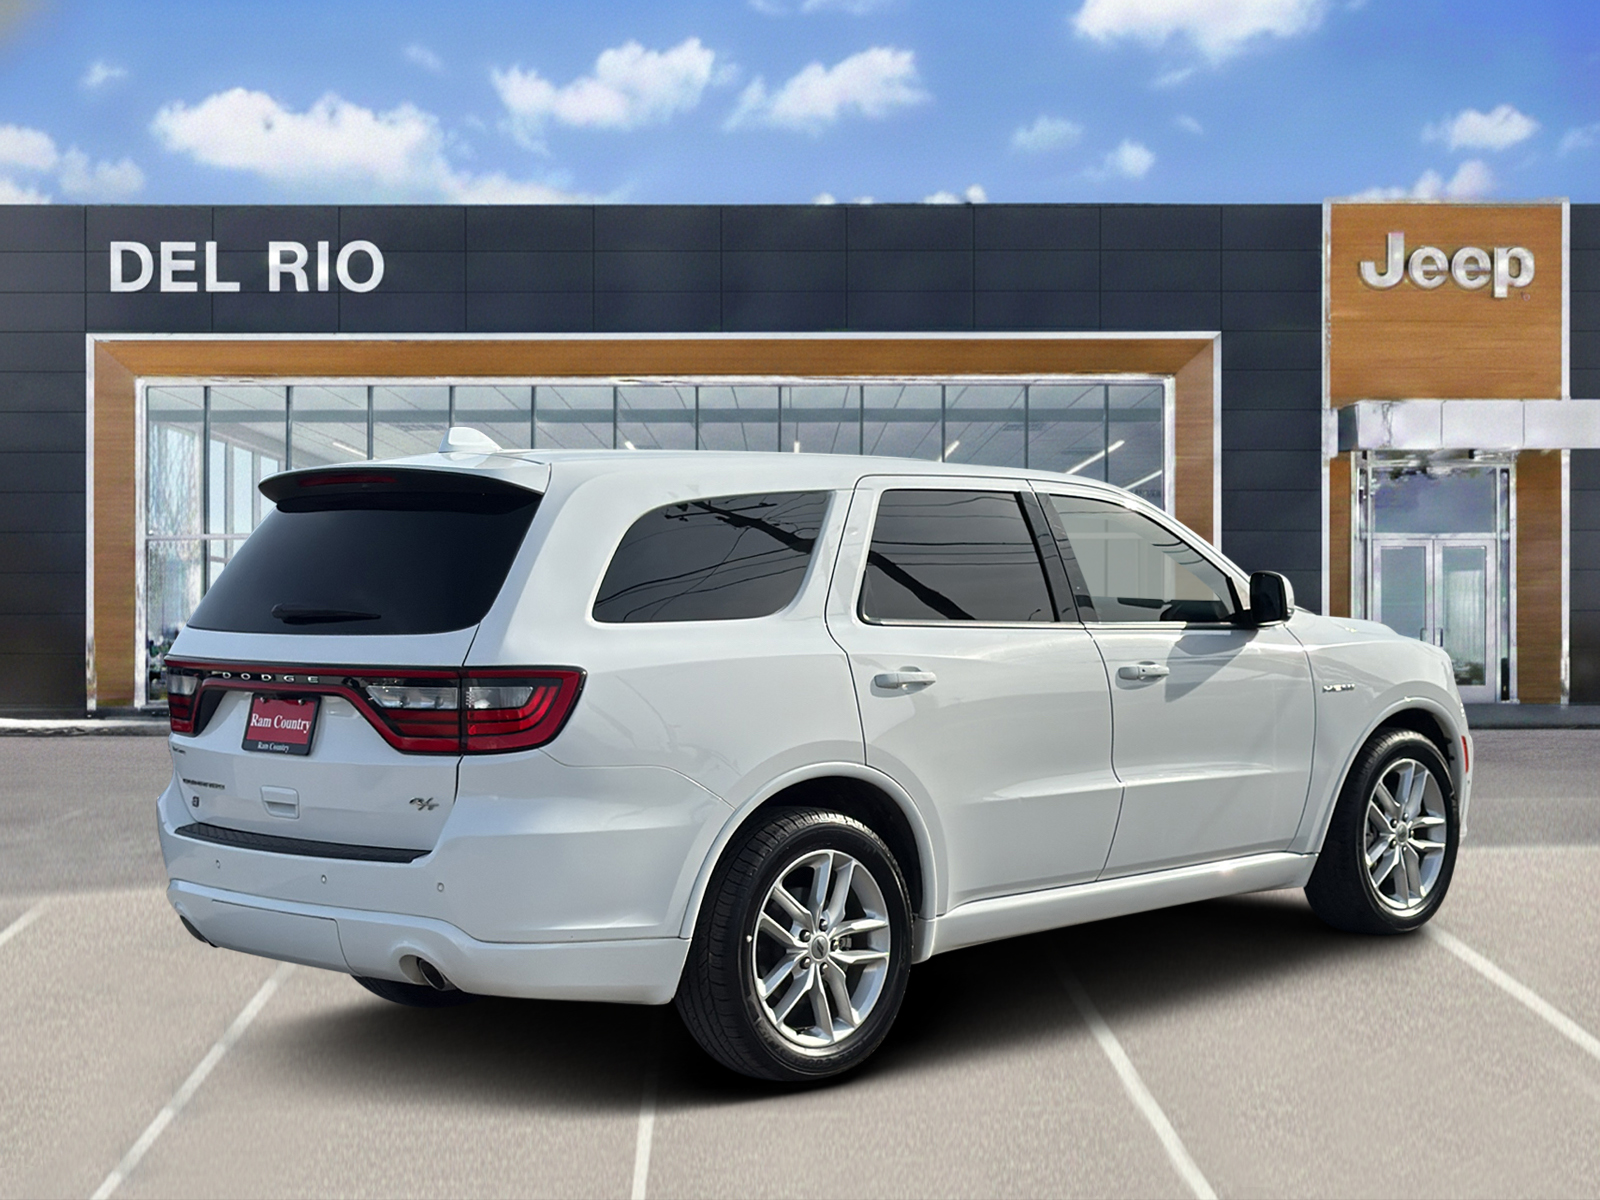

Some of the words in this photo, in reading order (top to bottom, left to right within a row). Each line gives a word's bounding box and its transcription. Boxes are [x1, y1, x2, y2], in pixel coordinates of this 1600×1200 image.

[110, 241, 241, 293] DEL
[268, 240, 385, 293] RIO
[1360, 231, 1535, 298] Jeep
[221, 671, 320, 684] DODGE
[250, 713, 272, 728] Ram
[273, 714, 311, 734] Country
[257, 742, 269, 750] Ram
[269, 743, 290, 753] Country
